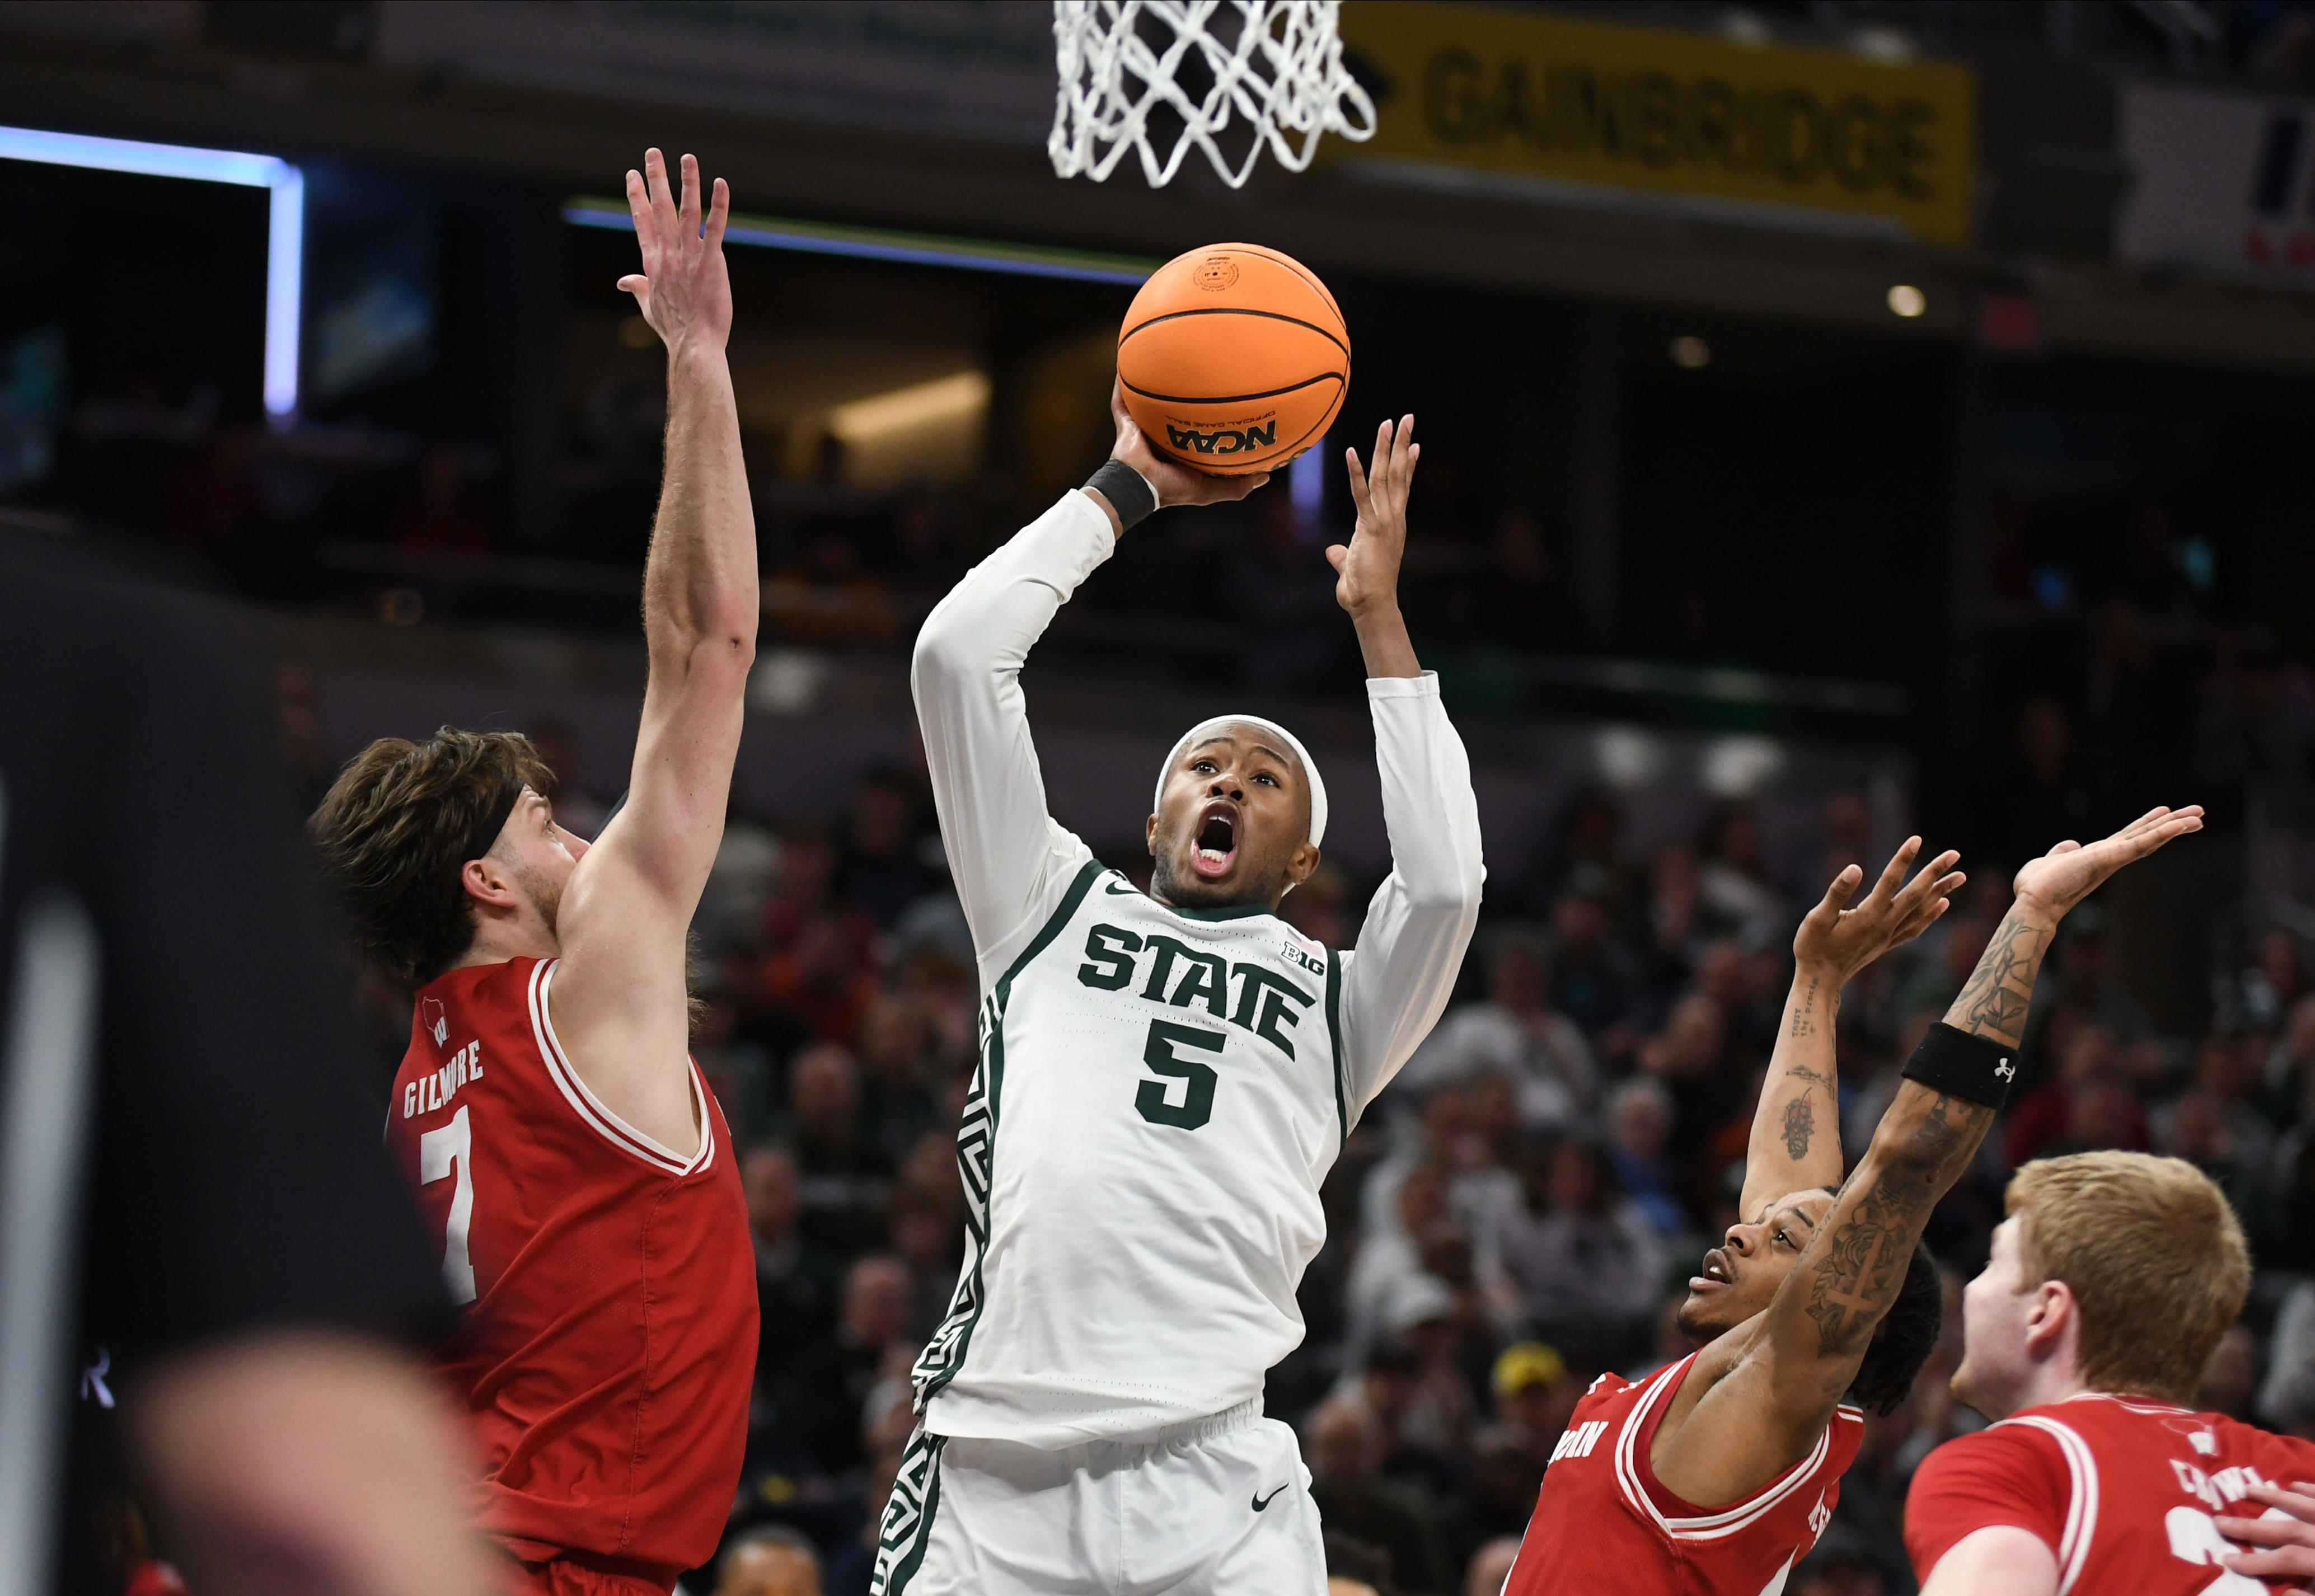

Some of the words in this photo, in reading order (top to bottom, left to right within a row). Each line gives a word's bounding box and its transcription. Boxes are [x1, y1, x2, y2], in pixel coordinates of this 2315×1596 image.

[1164, 415, 1191, 427] BALL
[1166, 419, 1277, 455] NCAA
[1228, 410, 1276, 426] OFFICIAL
[1077, 923, 1317, 1063] STATE
[404, 1039, 484, 1119] GILMORE
[1134, 1017, 1227, 1131] 5
[420, 1104, 477, 1307] 7
